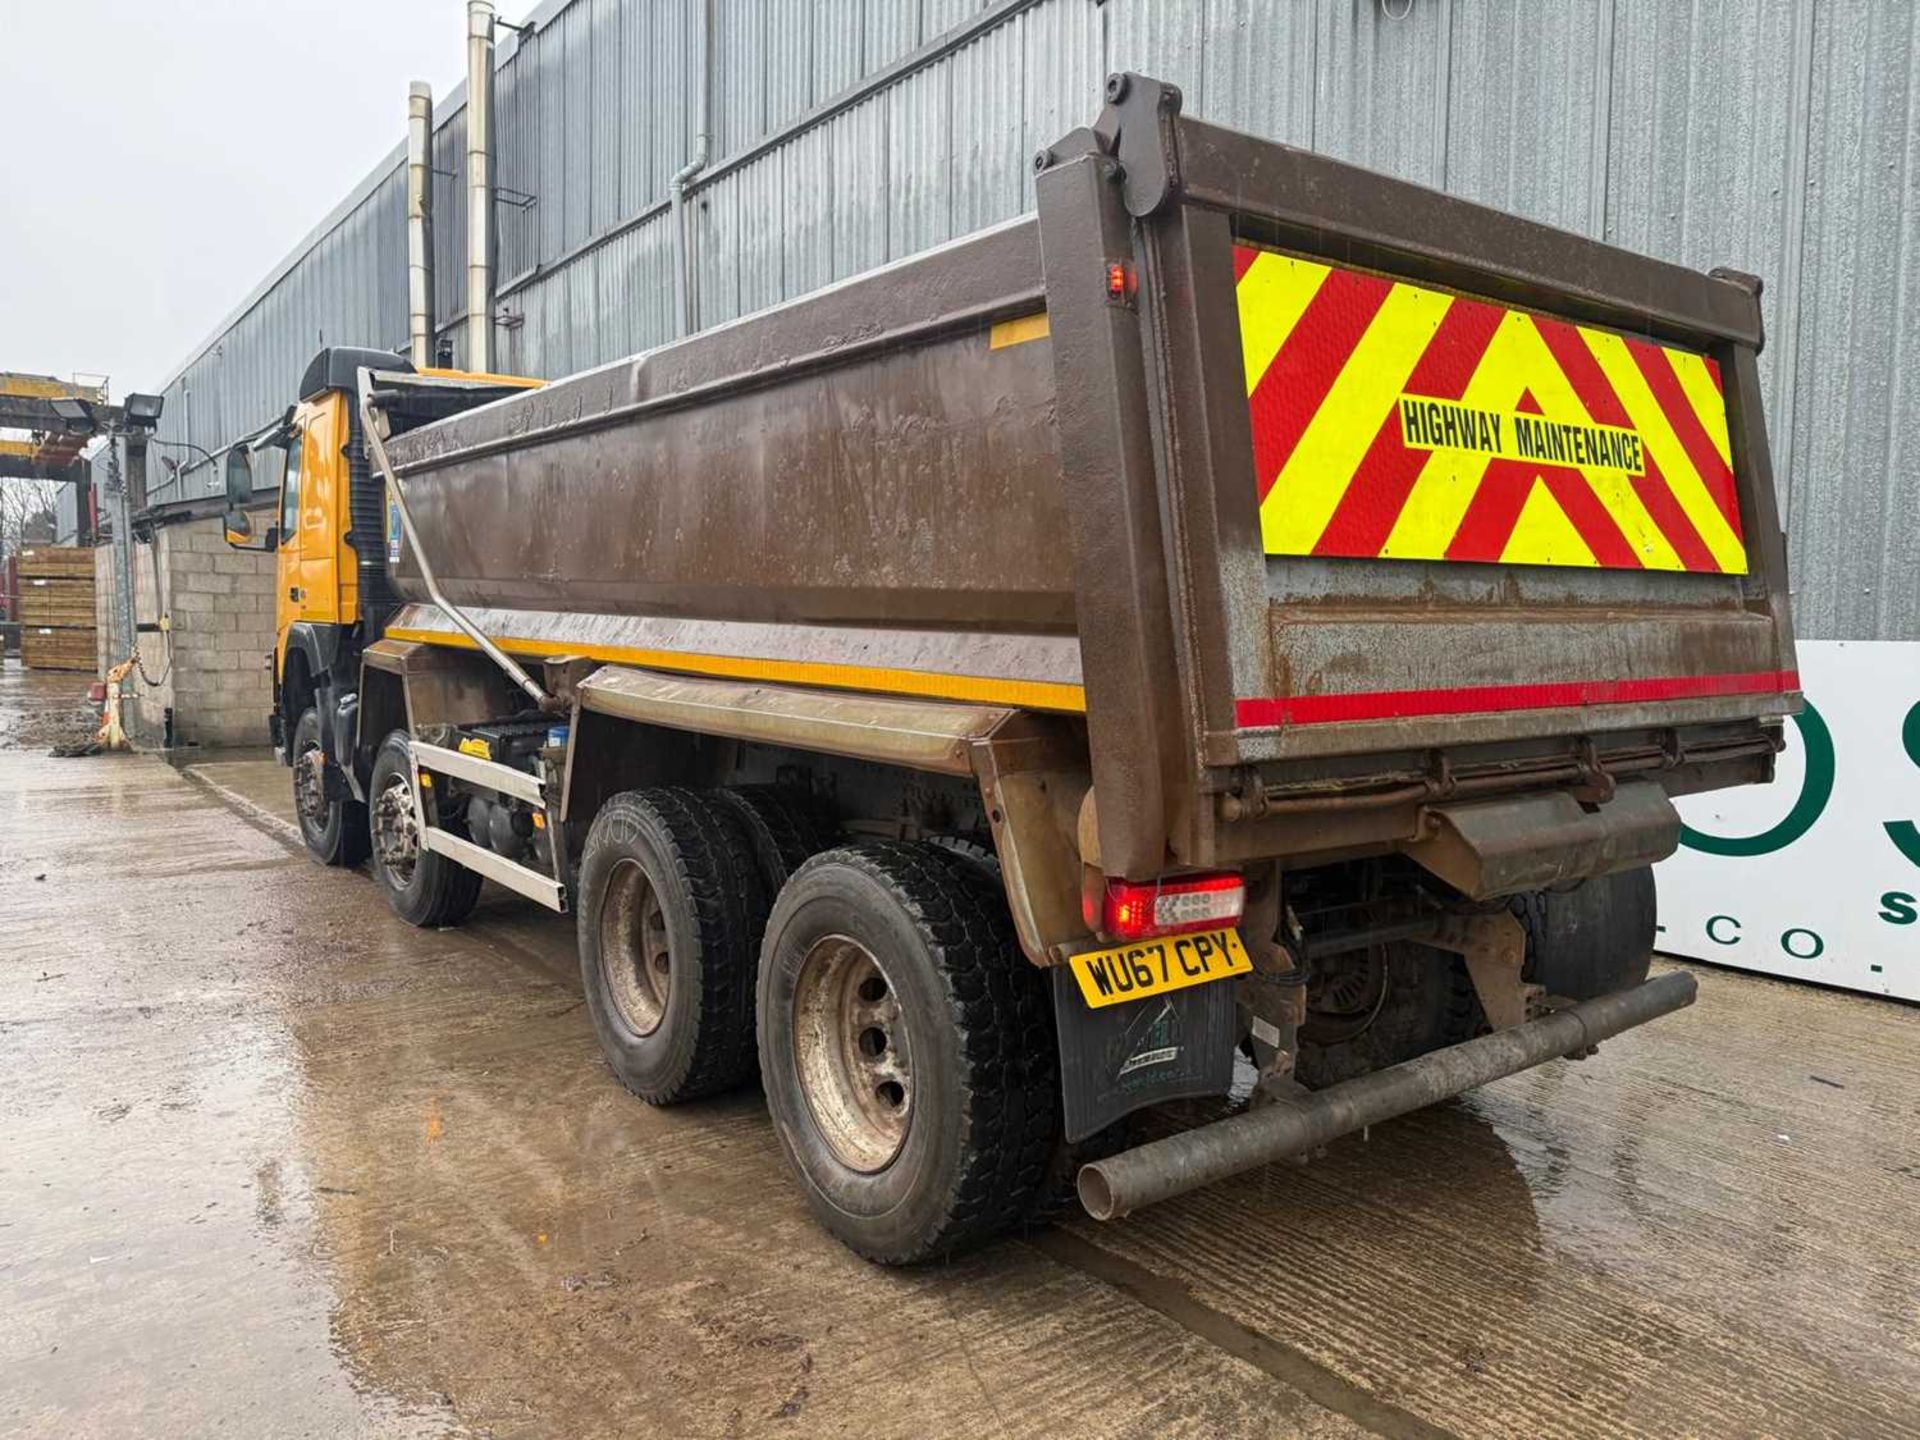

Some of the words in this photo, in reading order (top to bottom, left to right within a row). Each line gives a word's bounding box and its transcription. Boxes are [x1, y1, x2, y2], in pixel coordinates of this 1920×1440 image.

[1403, 400, 1501, 453] HIGHWAY
[1514, 416, 1642, 471] MAINTENANCE
[1085, 944, 1169, 996] WU67
[1174, 931, 1233, 977] CPY
